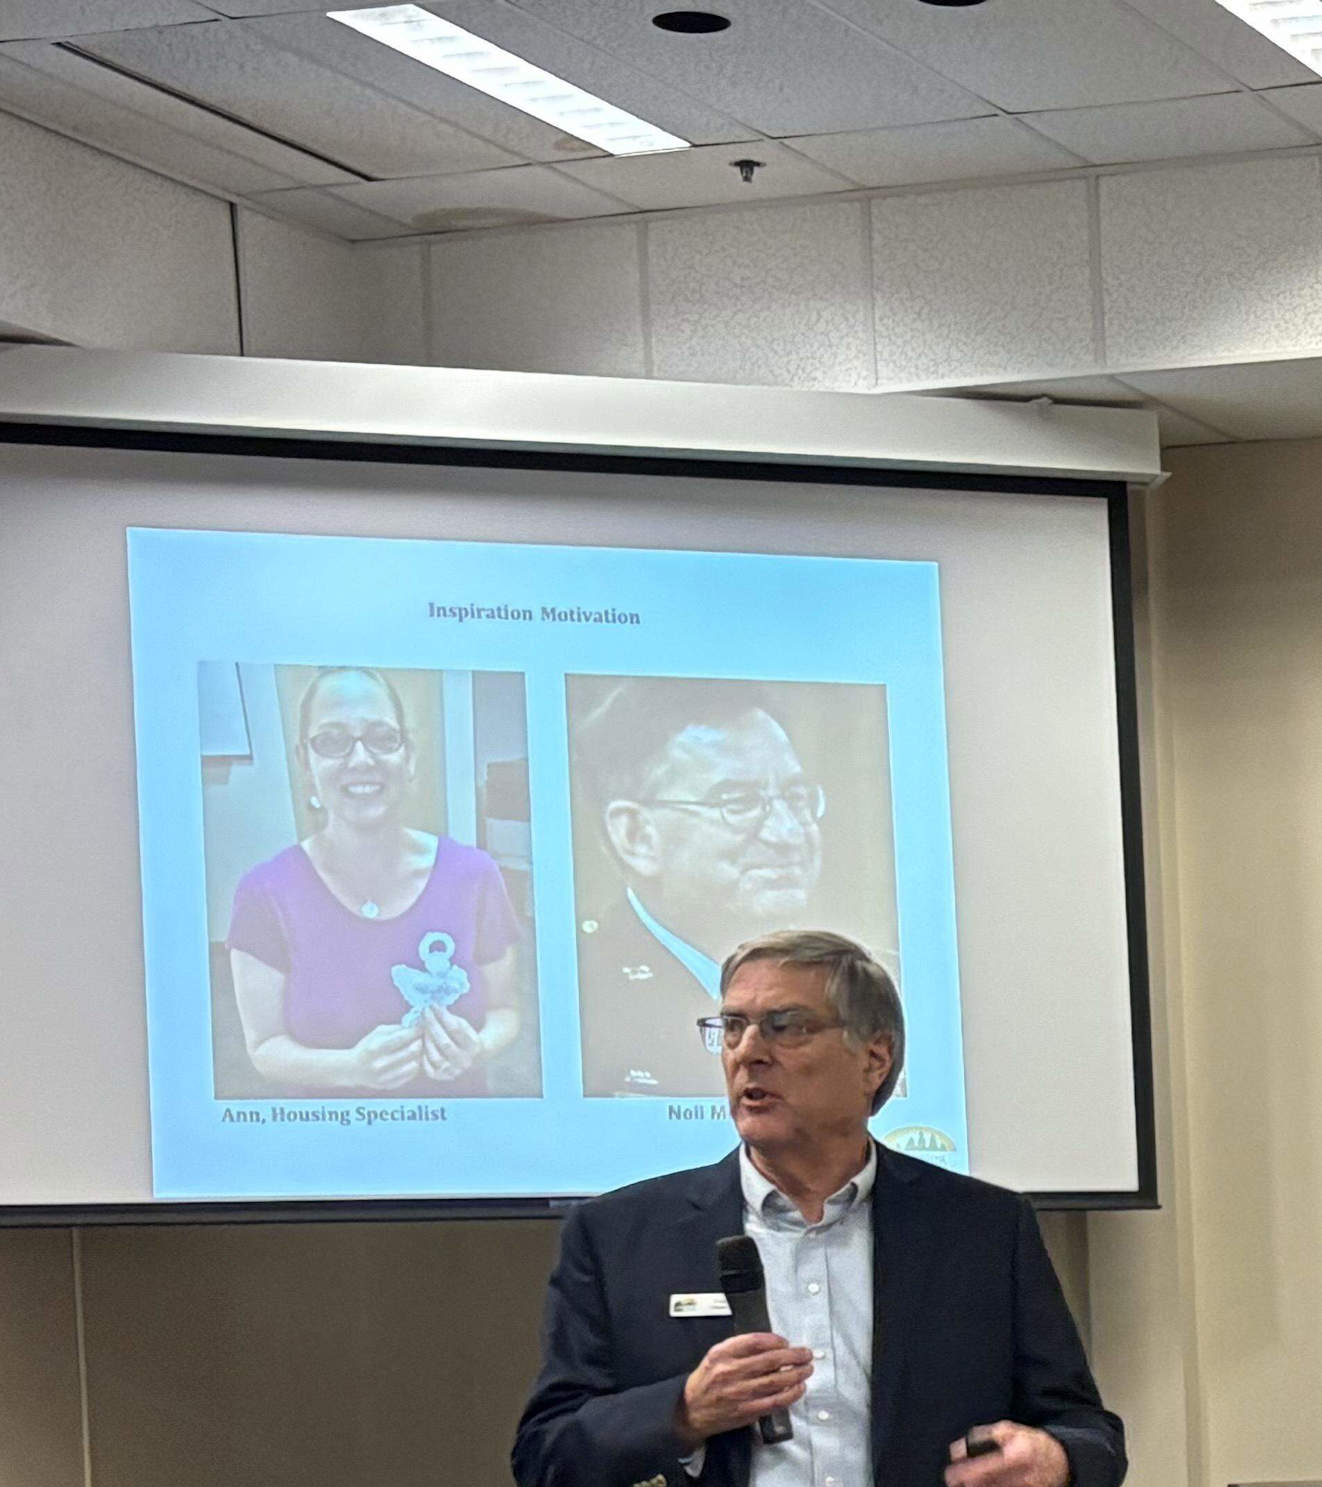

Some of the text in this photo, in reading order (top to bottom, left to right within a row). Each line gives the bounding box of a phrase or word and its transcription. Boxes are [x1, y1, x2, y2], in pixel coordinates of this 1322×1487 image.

[428, 602, 641, 624] Inspiration Motivation
[222, 1105, 447, 1125] Ann, Housing Specialist
